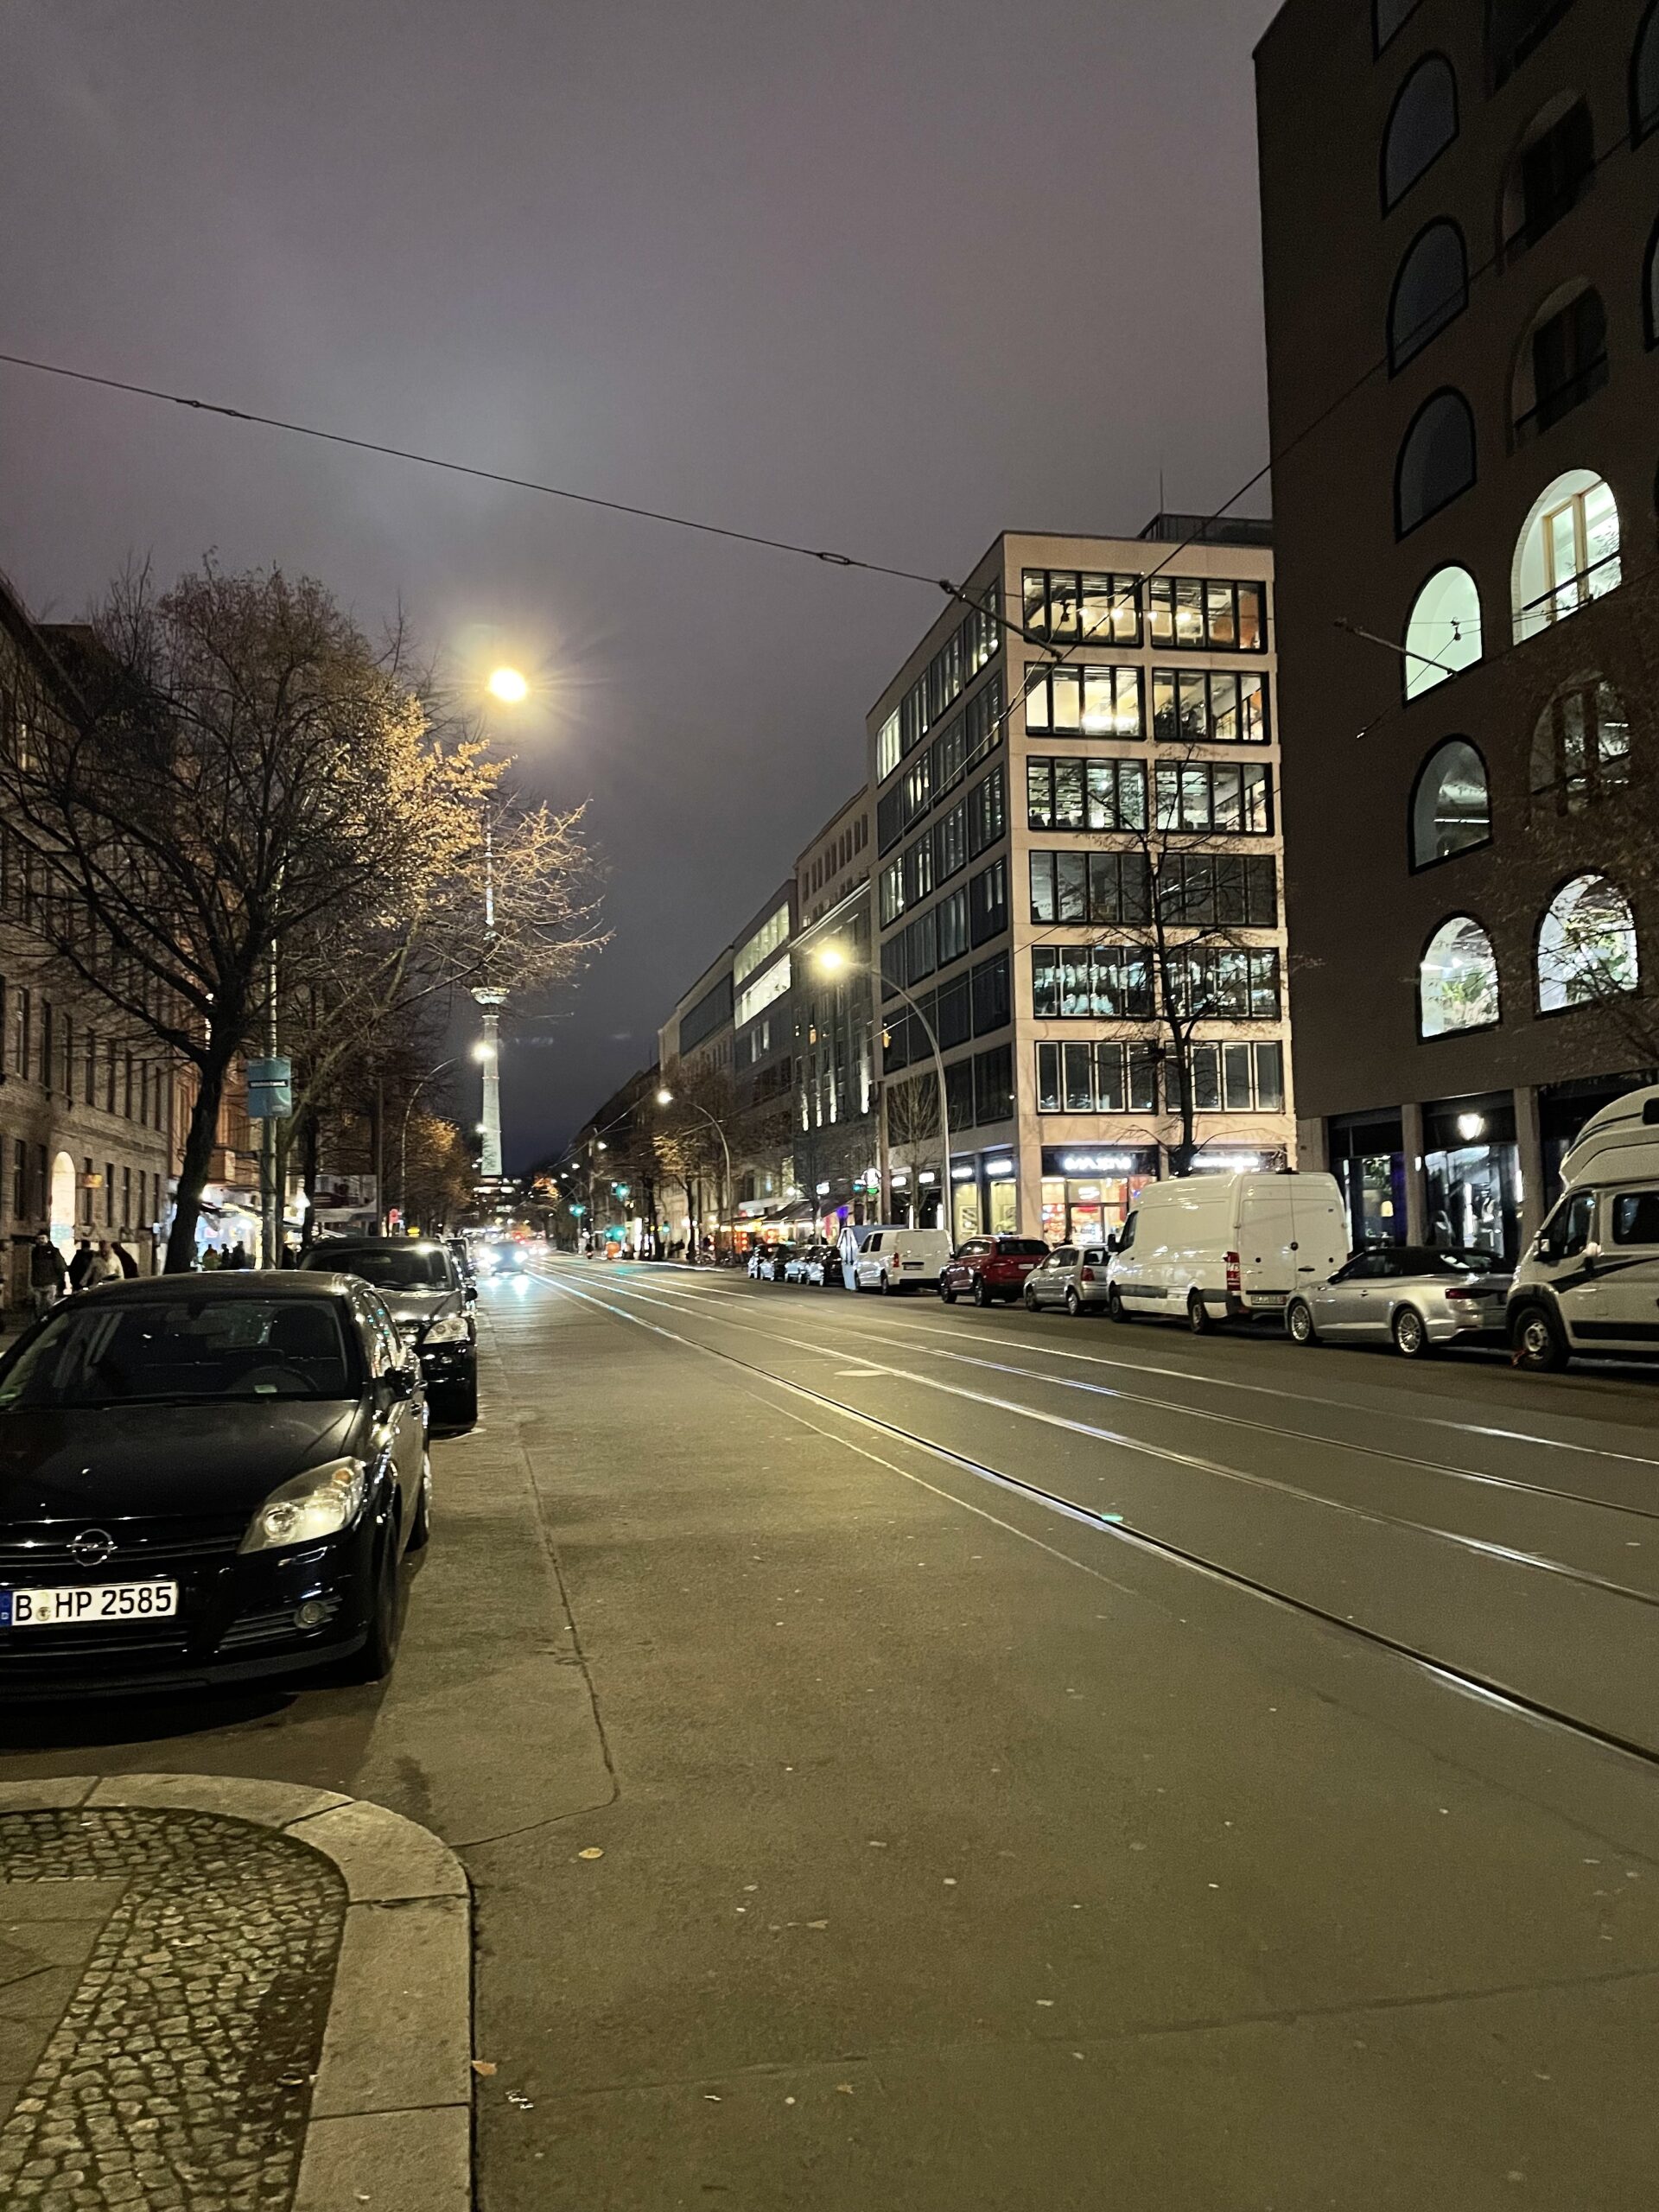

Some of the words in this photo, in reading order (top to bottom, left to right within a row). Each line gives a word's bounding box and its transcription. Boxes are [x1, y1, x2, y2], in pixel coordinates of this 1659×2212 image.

[16, 1595, 32, 1621] B
[55, 1591, 92, 1618] HP
[101, 1586, 171, 1616] 2585
